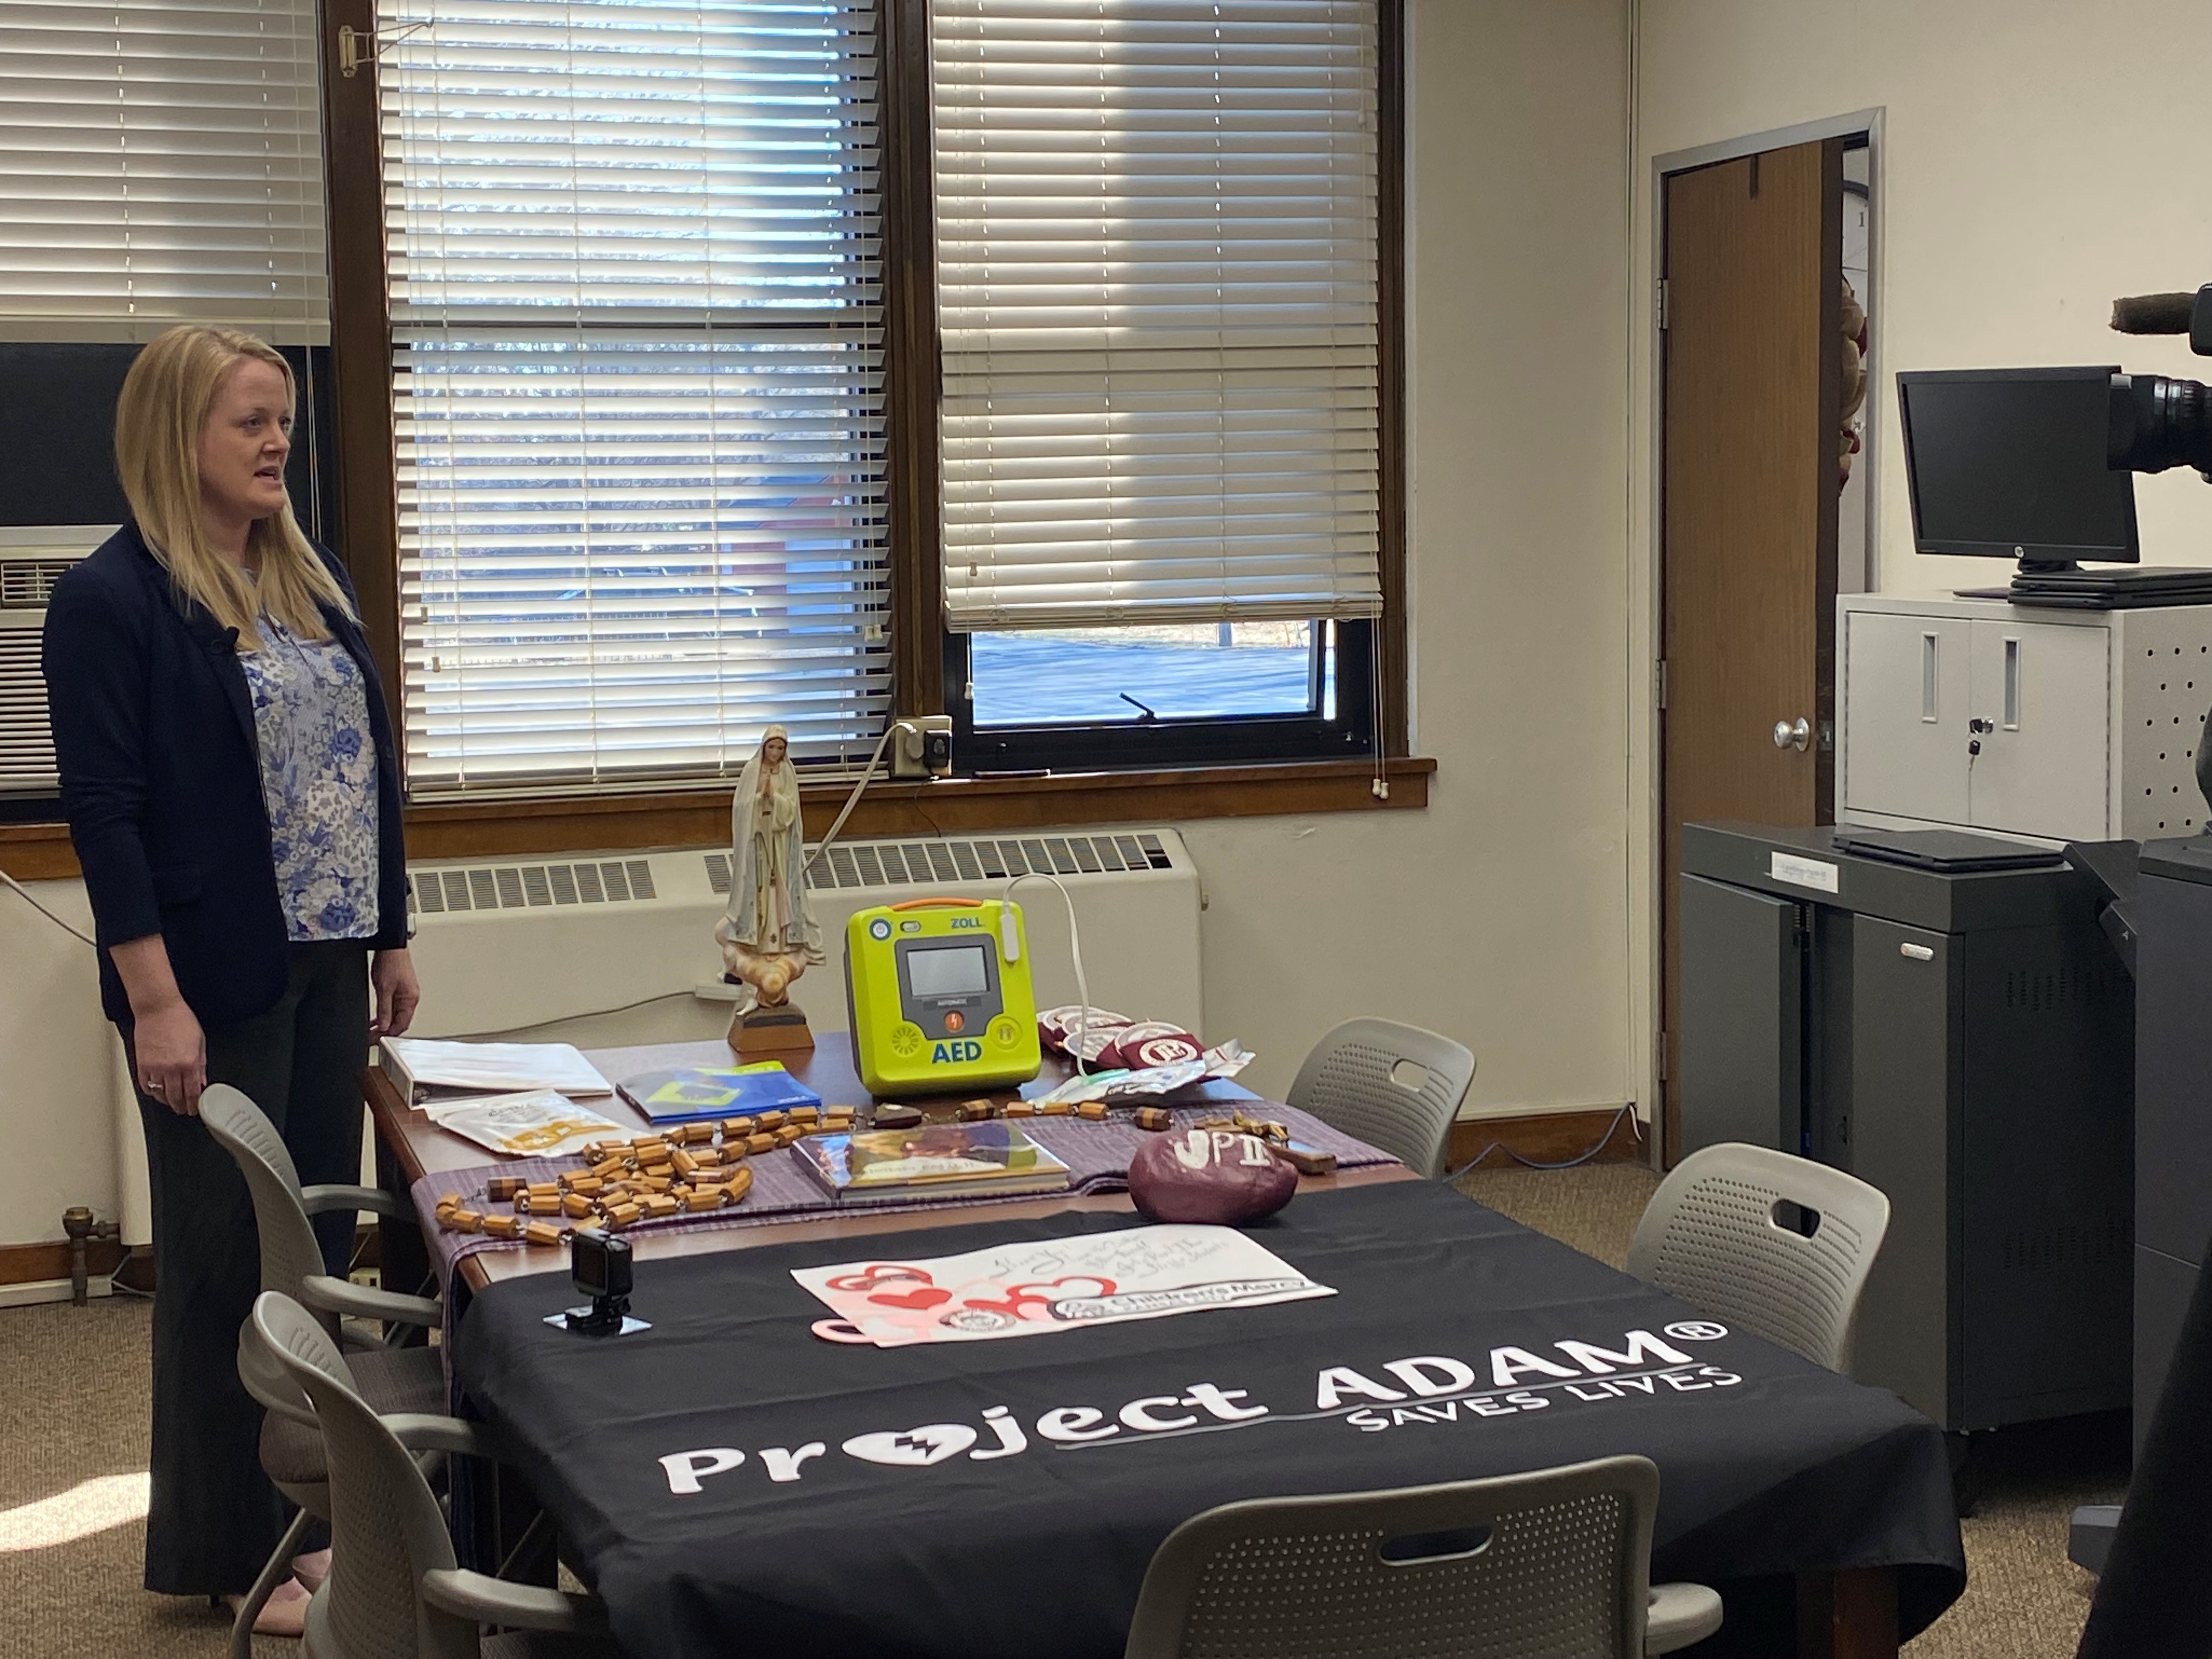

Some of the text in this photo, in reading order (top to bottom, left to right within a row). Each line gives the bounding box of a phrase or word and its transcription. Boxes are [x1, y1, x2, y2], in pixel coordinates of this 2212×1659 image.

[951, 917, 983, 929] ZOLL
[932, 1041, 982, 1064] AED
[1346, 1366, 1743, 1432] SAVES LIVES
